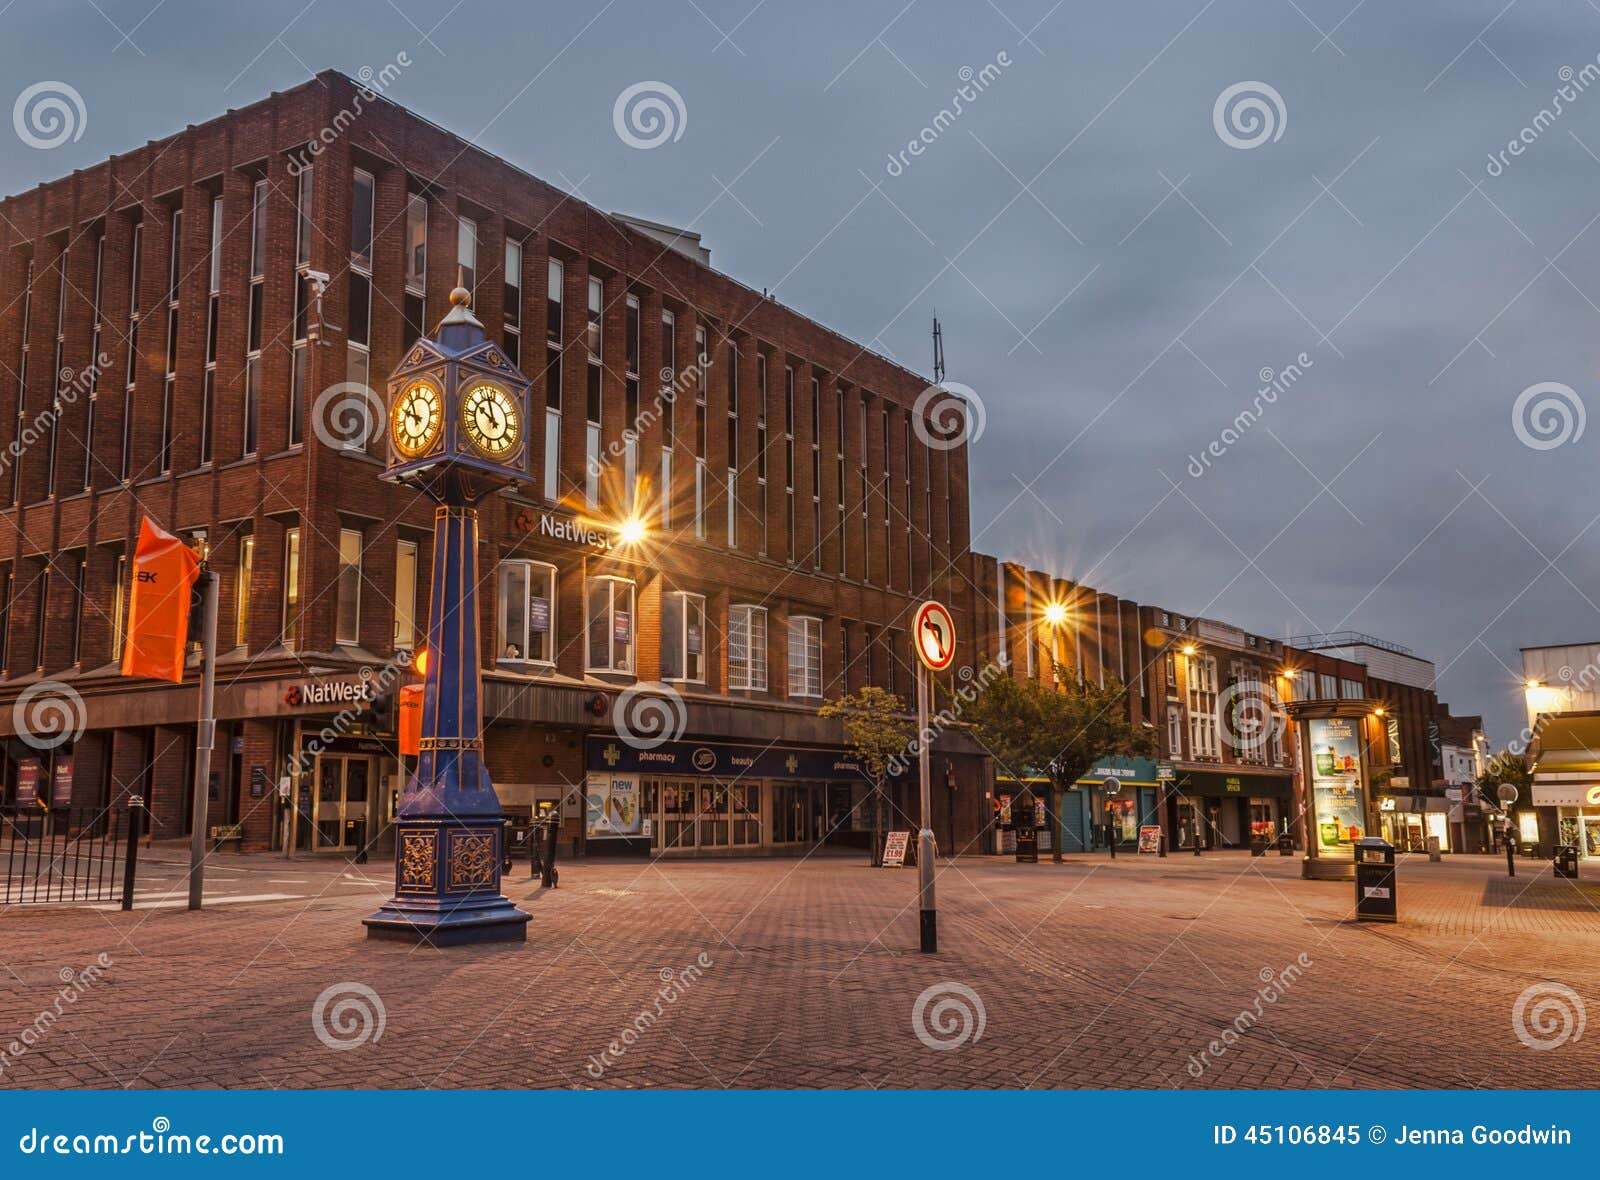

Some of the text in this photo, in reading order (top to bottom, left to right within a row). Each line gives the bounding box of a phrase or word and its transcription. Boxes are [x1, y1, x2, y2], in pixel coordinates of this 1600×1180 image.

[541, 514, 613, 550] NatWest
[303, 681, 369, 704] NatWest
[639, 751, 753, 767] pharmacy beauty
[612, 780, 632, 790] new
